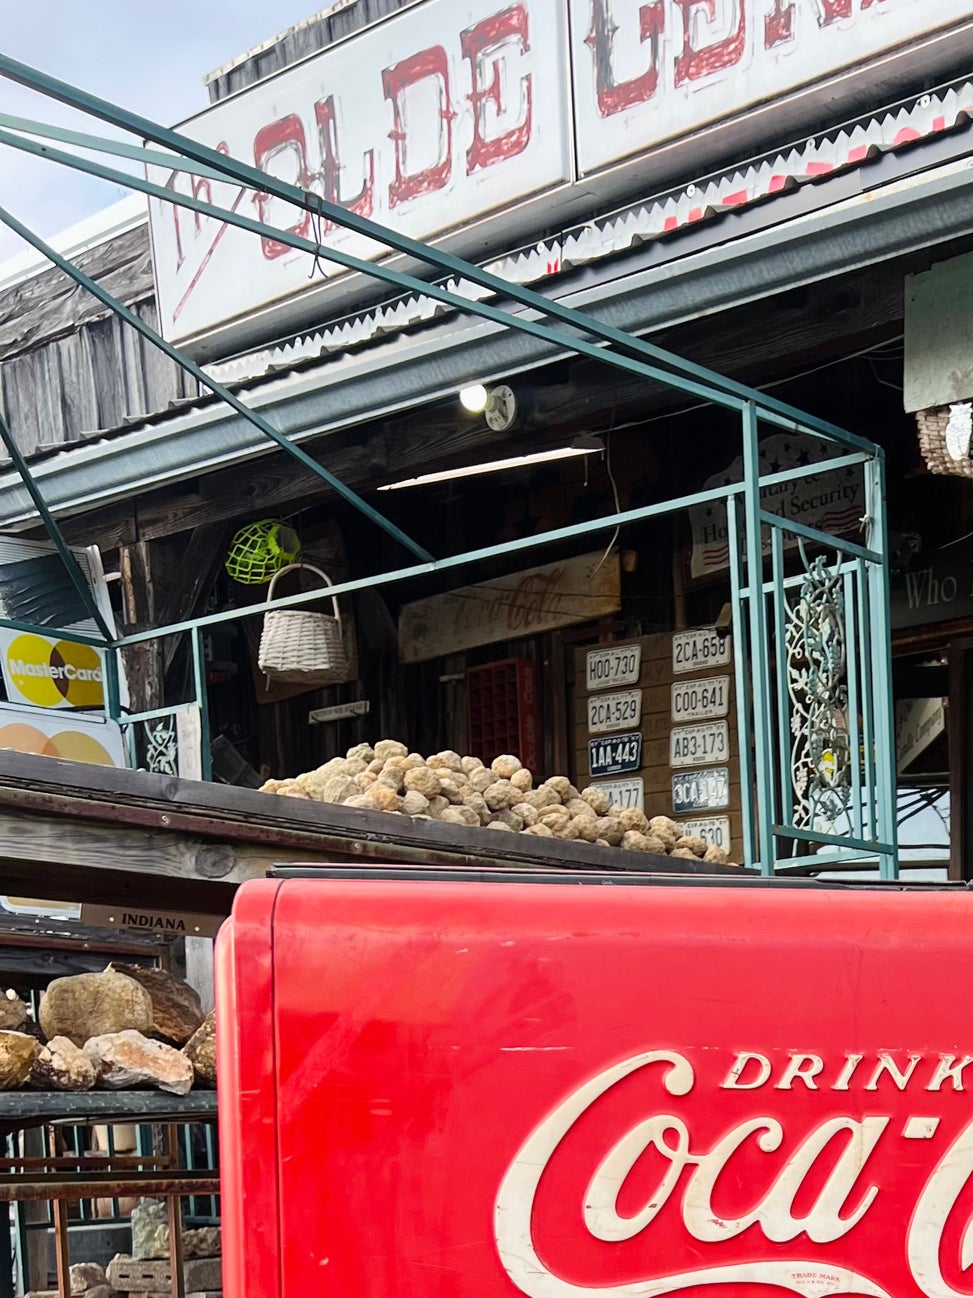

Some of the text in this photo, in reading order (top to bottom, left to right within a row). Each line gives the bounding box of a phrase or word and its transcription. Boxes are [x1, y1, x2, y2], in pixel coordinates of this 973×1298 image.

[253, 3, 532, 260] OLDE
[790, 484, 860, 514] Security
[905, 566, 958, 609] Who
[676, 636, 726, 664] 2CA-658
[591, 700, 637, 726] 2CA-529
[591, 741, 638, 769] 1AA-443
[674, 732, 725, 759] AB3-173
[122, 913, 186, 931] INDIANA
[791, 1271, 817, 1280] TRADE
[819, 1272, 841, 1283] MARK
